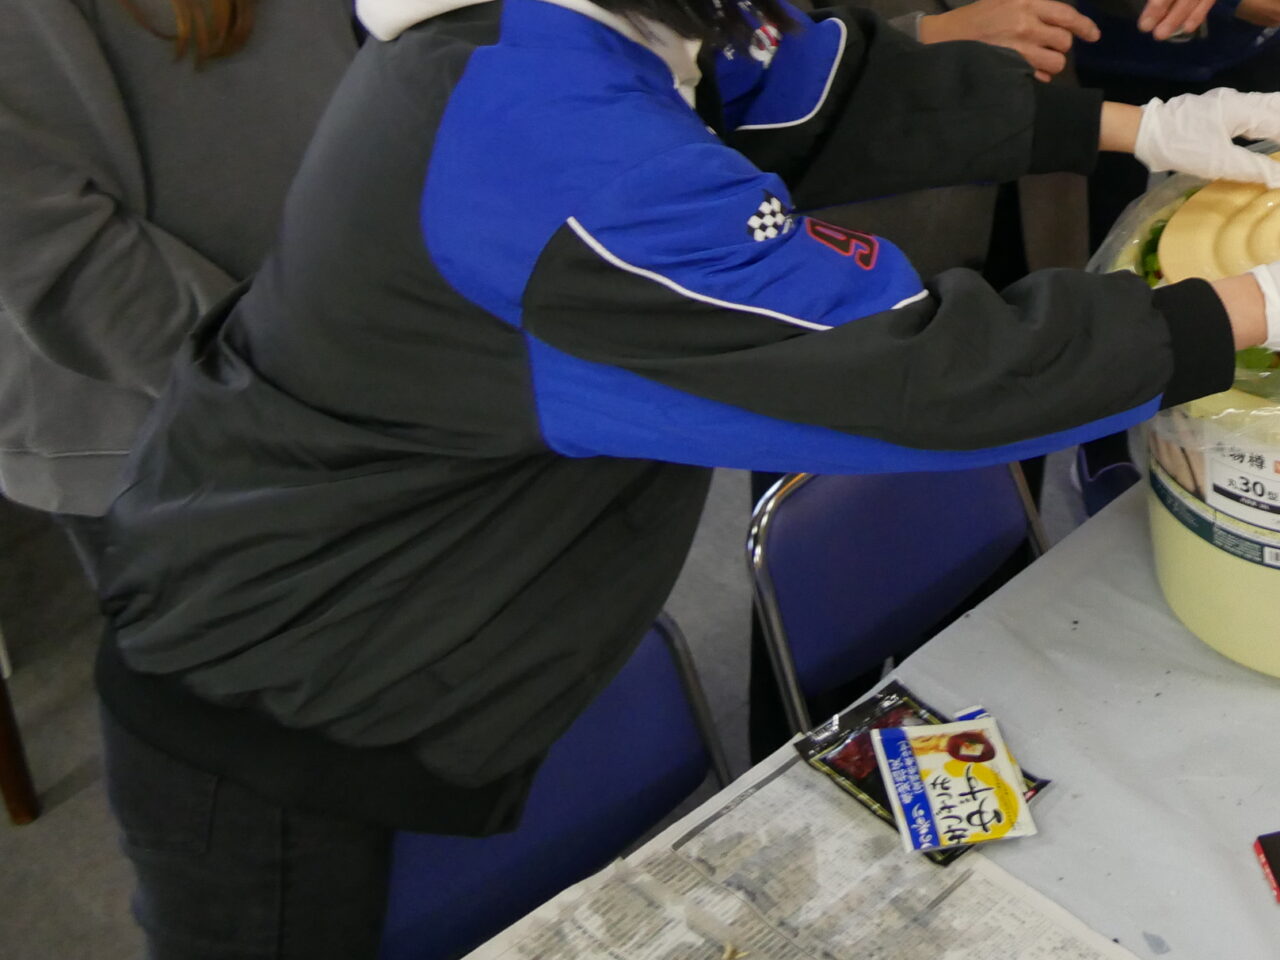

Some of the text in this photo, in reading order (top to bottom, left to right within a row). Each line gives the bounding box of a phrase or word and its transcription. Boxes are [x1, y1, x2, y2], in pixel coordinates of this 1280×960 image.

[929, 775, 969, 844] きざみ
[958, 764, 1003, 833] ゆず
